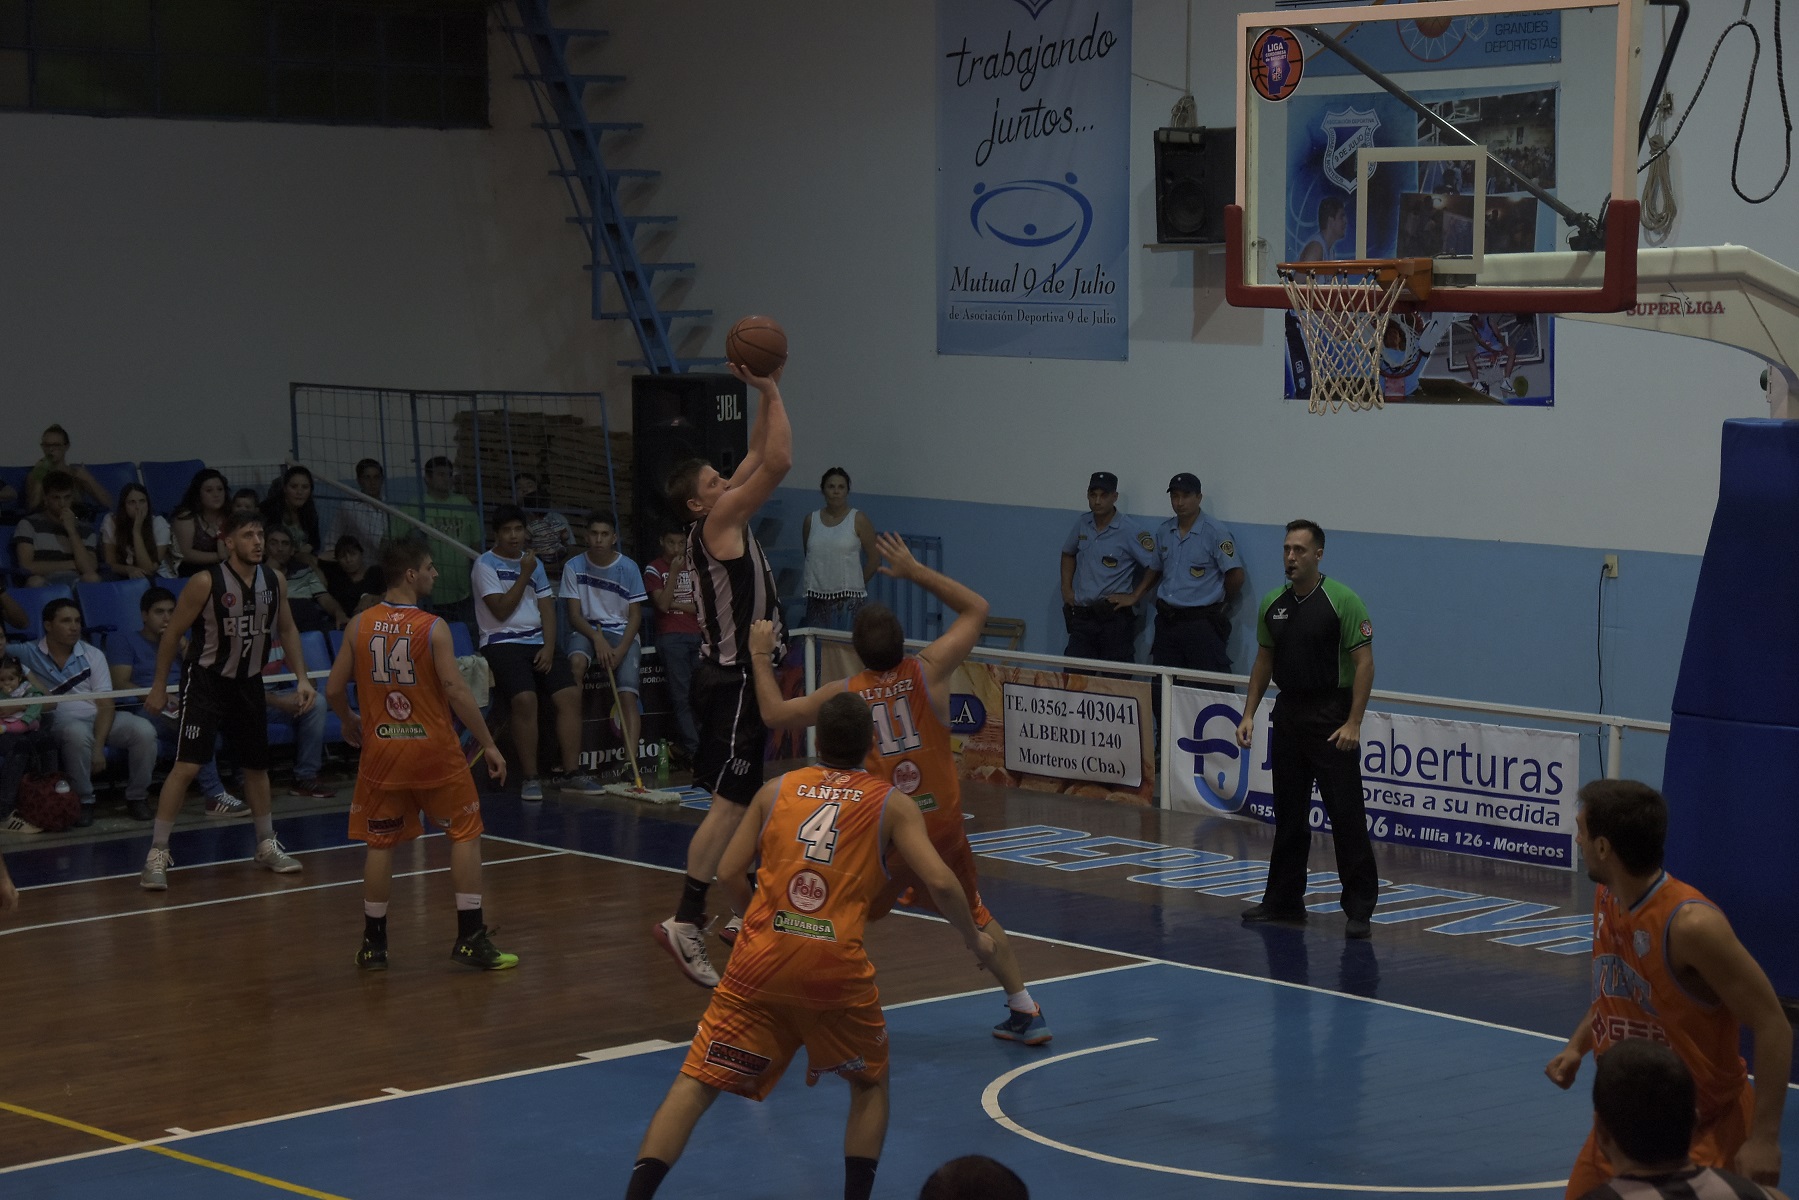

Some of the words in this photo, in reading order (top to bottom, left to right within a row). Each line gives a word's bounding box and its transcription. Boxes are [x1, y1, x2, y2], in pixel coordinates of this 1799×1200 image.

[1495, 20, 1549, 36] GRANDES
[946, 11, 1118, 92] trabajando
[1267, 42, 1284, 52] LIGA
[1484, 37, 1558, 54] DEPORTISTAS
[975, 97, 1094, 167] juntos...
[1347, 134, 1364, 151] JULIO
[950, 262, 1019, 293] Mutual
[1023, 267, 1037, 298] 9
[1042, 262, 1065, 294] de
[1068, 263, 1116, 301] Julio
[949, 306, 960, 320] de
[962, 307, 1013, 321] Asociación
[1017, 309, 1064, 325] Deportiva
[1067, 311, 1075, 324] 9
[1077, 308, 1089, 324] de
[1092, 309, 1117, 327] Julio
[1686, 300, 1724, 315] LIGA
[716, 394, 741, 422] JBL
[223, 612, 271, 637] BELL
[373, 621, 400, 634] BRIA
[241, 639, 253, 658] 7
[369, 635, 416, 685] 14
[1005, 694, 1027, 712] TE.
[870, 694, 921, 756] 11
[1019, 723, 1087, 746] ALBERDI
[1090, 731, 1122, 749] 1240
[1019, 747, 1078, 770] Morteros
[1081, 755, 1126, 777] (Cba.)
[796, 784, 864, 802] CAÑETE
[1362, 787, 1415, 807] presa
[1422, 795, 1436, 810] a
[1443, 797, 1469, 815] su
[1475, 802, 1561, 827] medida
[797, 802, 841, 864] 4
[1394, 823, 1416, 839] Bv.
[1455, 832, 1483, 848] 126
[1493, 838, 1564, 859] Morteros
[792, 875, 824, 899] Polo
